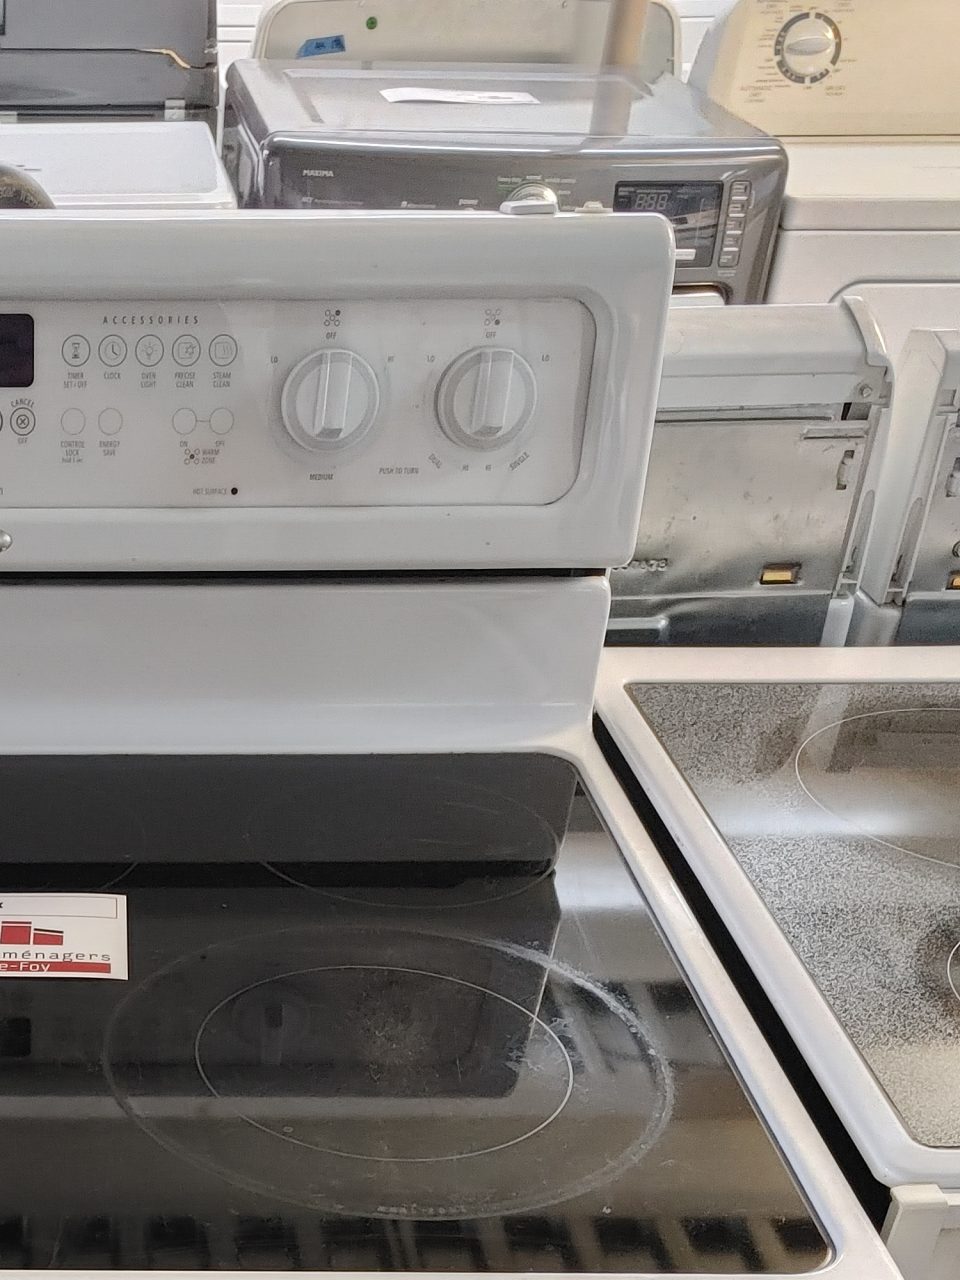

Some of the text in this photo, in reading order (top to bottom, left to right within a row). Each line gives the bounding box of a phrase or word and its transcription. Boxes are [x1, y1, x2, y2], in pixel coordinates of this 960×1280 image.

[302, 169, 335, 177] MAXIMA
[102, 315, 199, 325] ACCESSORIES
[325, 331, 337, 340] OFF
[485, 331, 497, 339] OFF
[67, 372, 84, 380] TIMER
[103, 372, 121, 380] CLOCK
[141, 372, 157, 380] OVEN
[174, 372, 196, 380] PRECISE
[212, 372, 232, 380] STEAM
[140, 381, 156, 389] LIGHT
[10, 398, 35, 408] CANCEL
[99, 440, 121, 448] ENERGY
[509, 451, 530, 472] SINGLE
[378, 467, 419, 475] PUSH TO TURN
[309, 473, 334, 481] MEDIUM
